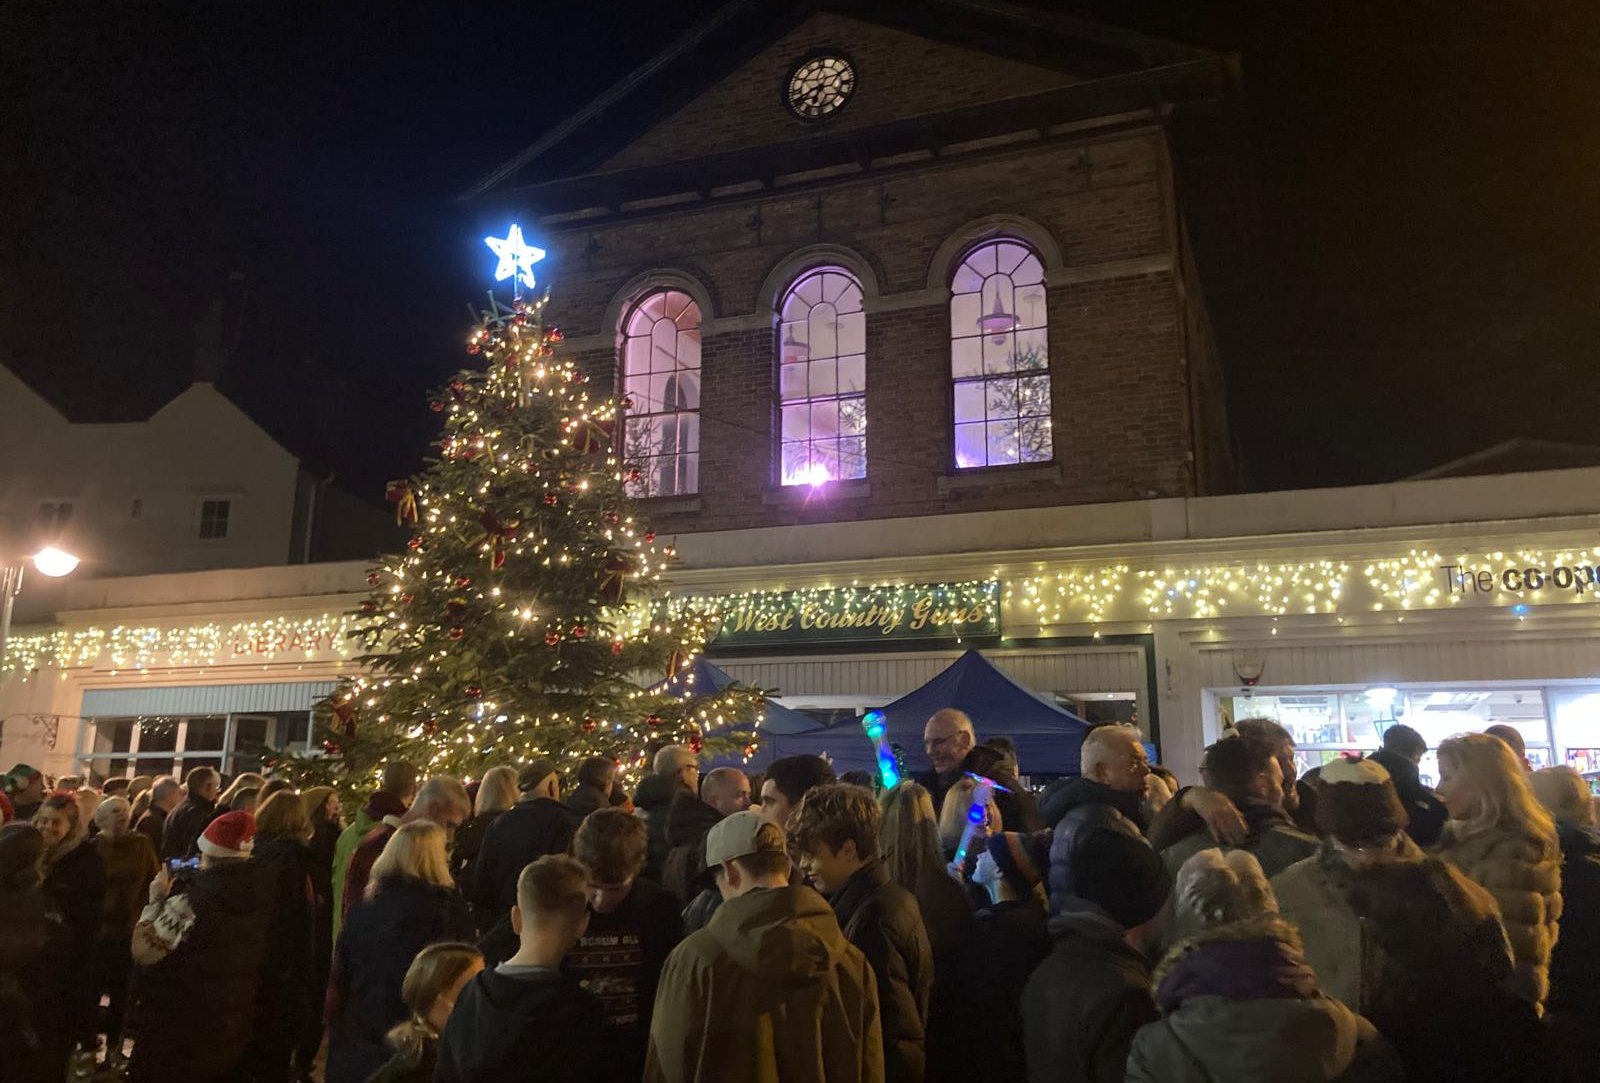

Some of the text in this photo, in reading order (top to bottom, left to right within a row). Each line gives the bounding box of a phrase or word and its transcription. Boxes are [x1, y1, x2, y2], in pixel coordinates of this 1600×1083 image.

[1439, 565, 1600, 594] The co-op
[732, 596, 986, 635] West Country Guns
[234, 628, 340, 655] LIBRARY
